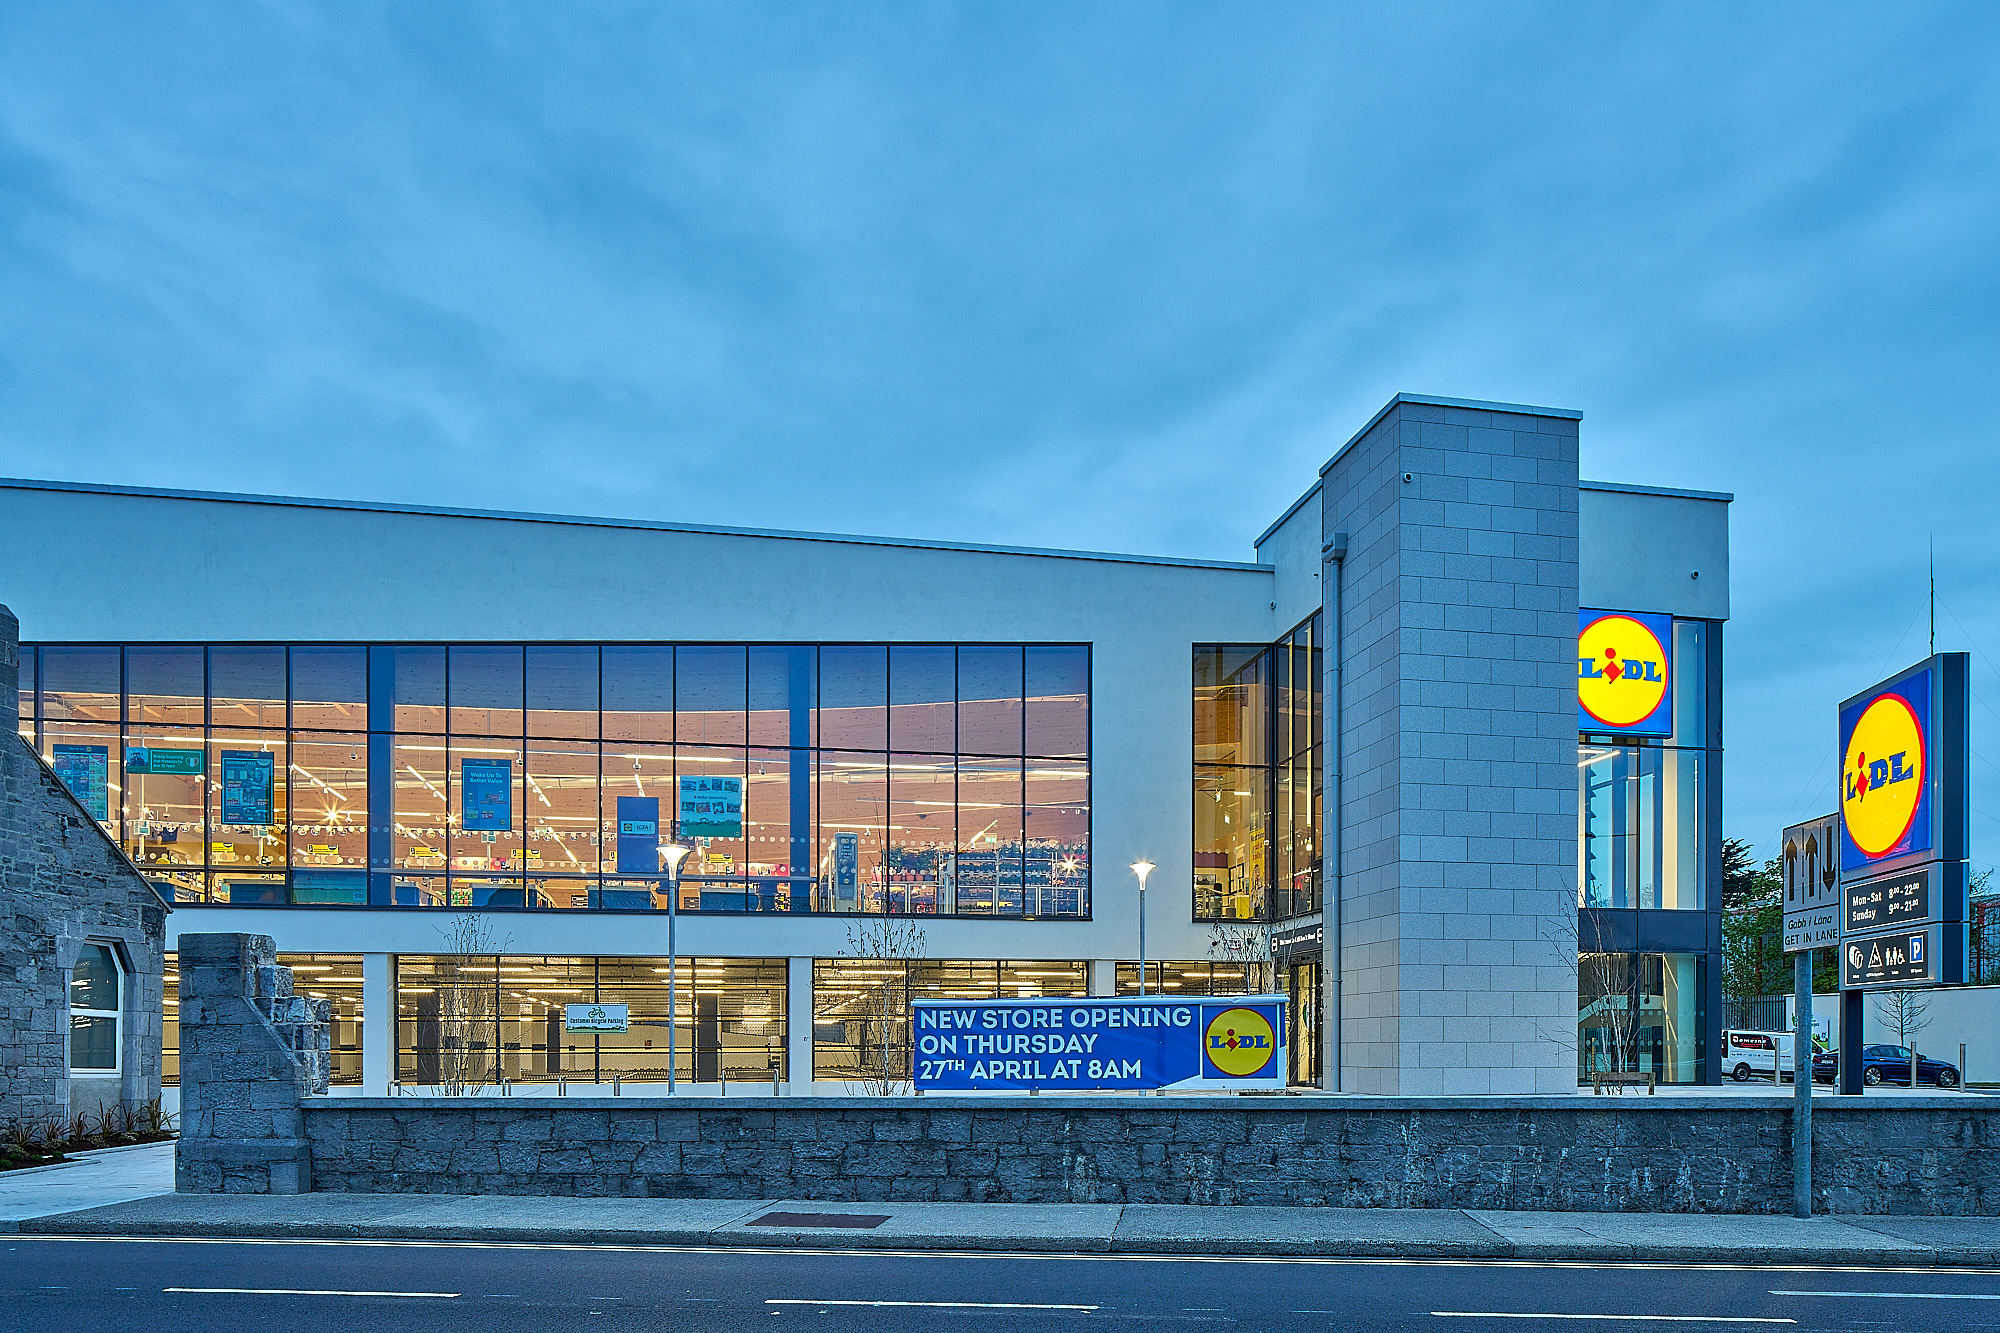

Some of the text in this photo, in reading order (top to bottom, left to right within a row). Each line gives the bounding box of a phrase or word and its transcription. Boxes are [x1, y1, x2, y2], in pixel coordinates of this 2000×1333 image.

[1579, 648, 1661, 684] LIDL
[1845, 751, 1913, 803] LIDL
[1788, 918, 1806, 930] Gabh
[1852, 909, 1876, 921] Sunday
[1785, 927, 1837, 945] GET IN LANE
[1913, 942, 1921, 959] P
[920, 1007, 1192, 1029] NEW STORE OPENING
[920, 1034, 1098, 1054] ON THURSDAY
[1210, 1029, 1269, 1052] LIDL
[970, 1060, 1047, 1079] APRIL
[1050, 1059, 1082, 1079] AT
[1088, 1059, 1142, 1079] 8AM
